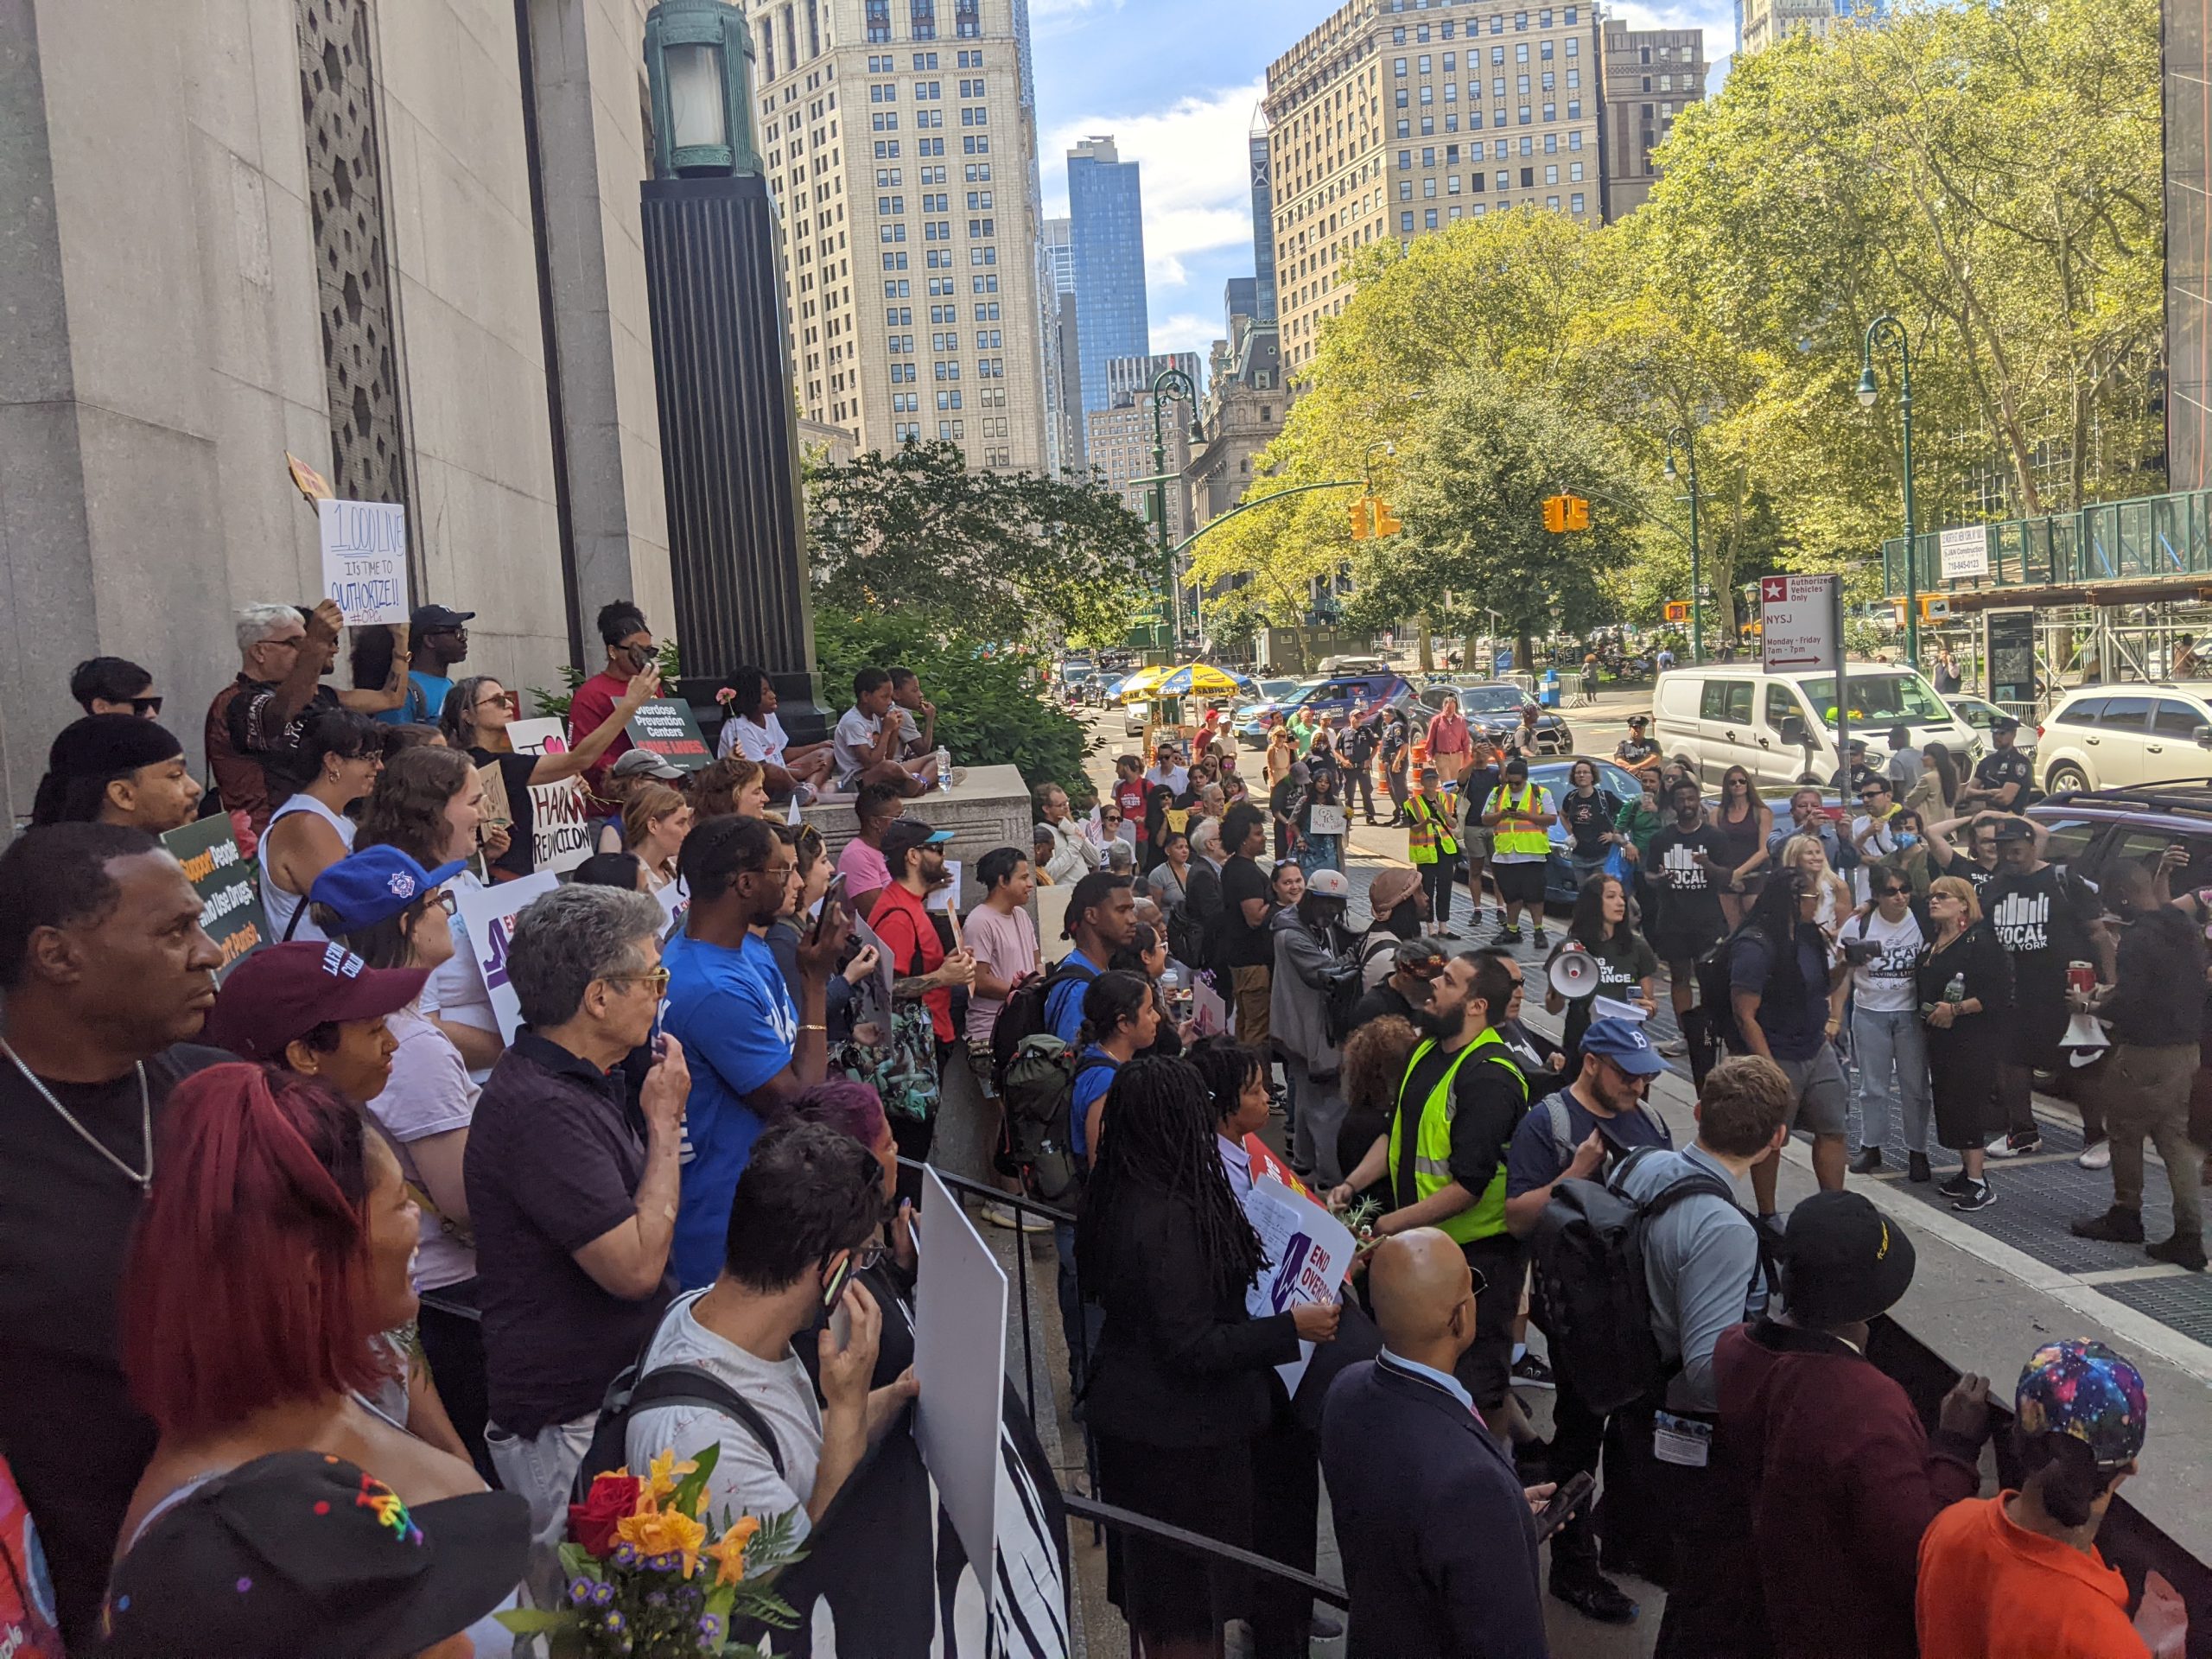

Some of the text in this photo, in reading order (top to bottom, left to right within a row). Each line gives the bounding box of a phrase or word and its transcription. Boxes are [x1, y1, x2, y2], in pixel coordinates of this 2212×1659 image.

[361, 561, 380, 576] TIME
[381, 560, 394, 575] TO
[1791, 577, 1832, 586] Authorized
[1766, 614, 1792, 624] NYSJ
[1767, 638, 1793, 646] Monday
[634, 715, 685, 727] Prevention
[646, 727, 684, 738] Centers
[637, 740, 708, 754] SAVE LIVES.
[532, 785, 588, 829] HARM
[180, 838, 239, 883] Support People
[211, 890, 230, 917] Use
[226, 880, 255, 908] Drugs,
[1994, 924, 2048, 944] VOCAL
[2018, 939, 2048, 951] YORK
[1630, 1031, 1647, 1050] B
[1309, 1244, 1331, 1273] END
